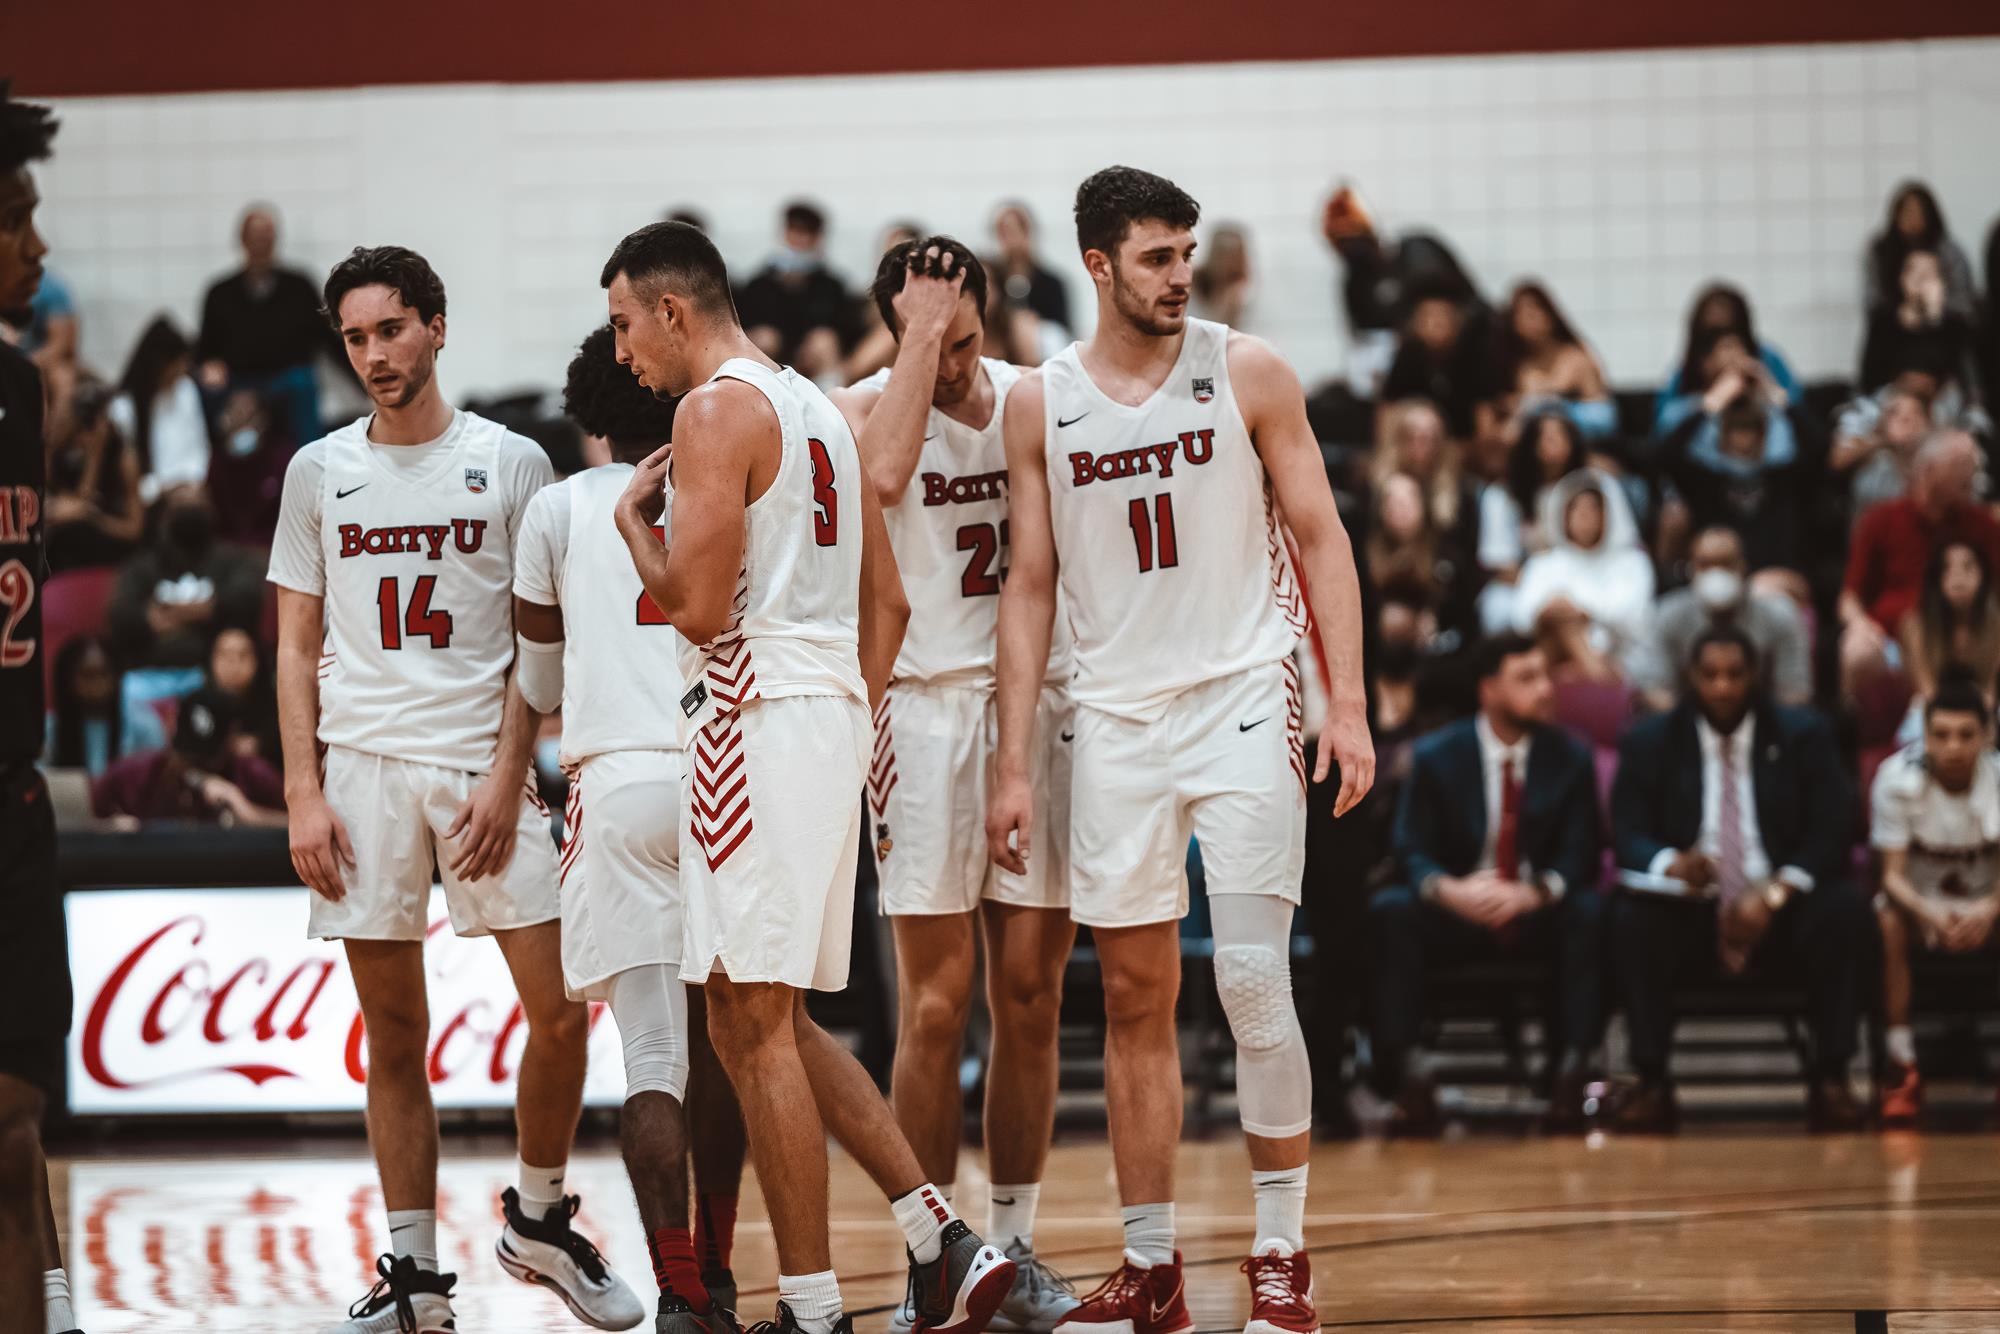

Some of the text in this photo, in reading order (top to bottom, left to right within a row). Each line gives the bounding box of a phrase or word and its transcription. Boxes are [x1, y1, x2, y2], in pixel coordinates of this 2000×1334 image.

[807, 437, 838, 547] 3
[921, 470, 1010, 506] Barr
[956, 518, 1010, 598] 2
[1128, 492, 1178, 573] 11
[377, 575, 453, 650] 14
[81, 914, 606, 1091] Coca ol
